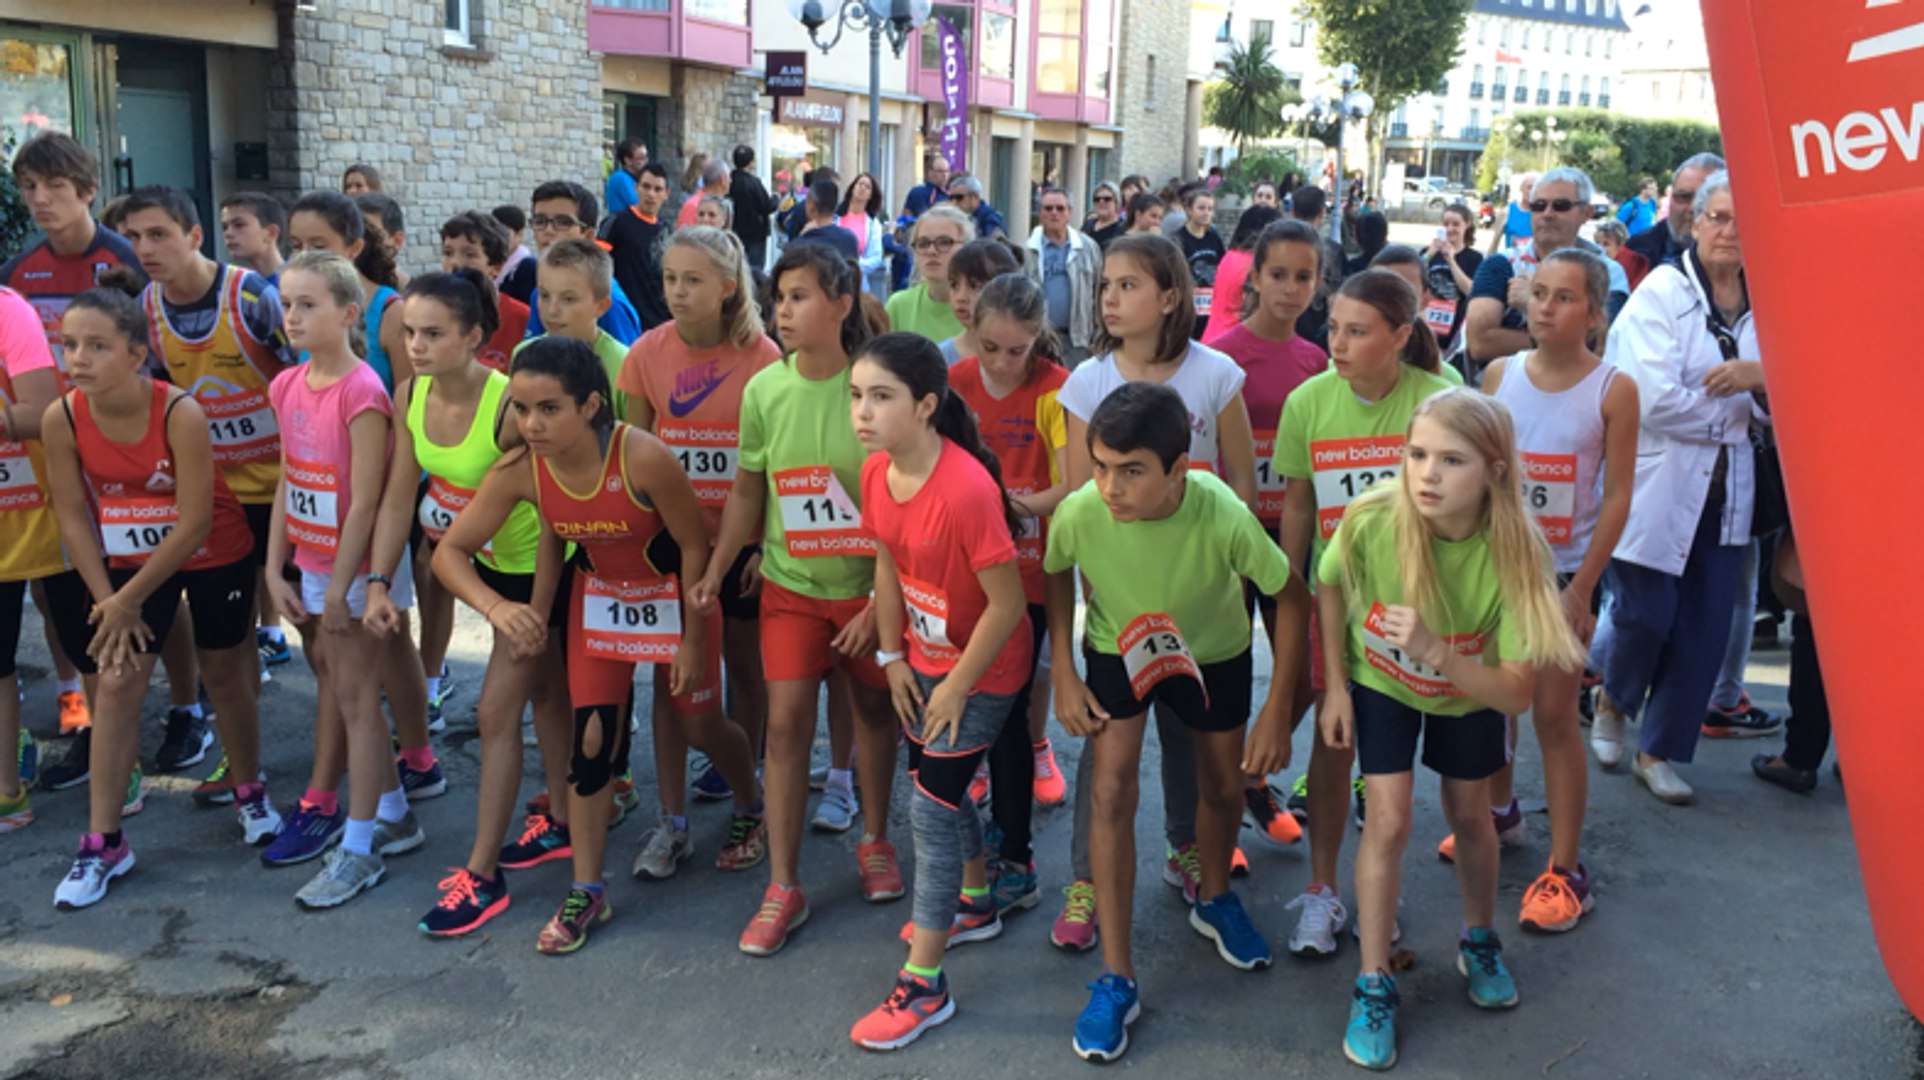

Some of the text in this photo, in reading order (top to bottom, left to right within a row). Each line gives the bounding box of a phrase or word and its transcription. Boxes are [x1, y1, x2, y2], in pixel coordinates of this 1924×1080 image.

[674, 357, 719, 397] NIKE
[210, 418, 256, 440] 118
[661, 428, 687, 440] new
[680, 449, 728, 473] 130
[1315, 449, 1347, 464] new
[779, 475, 809, 489] new
[290, 489, 317, 517] 121
[803, 498, 853, 522] 11
[103, 507, 129, 518] new
[554, 521, 630, 534] DINAN
[790, 540, 819, 551] new
[607, 602, 659, 626] 108
[587, 639, 678, 656] new balance
